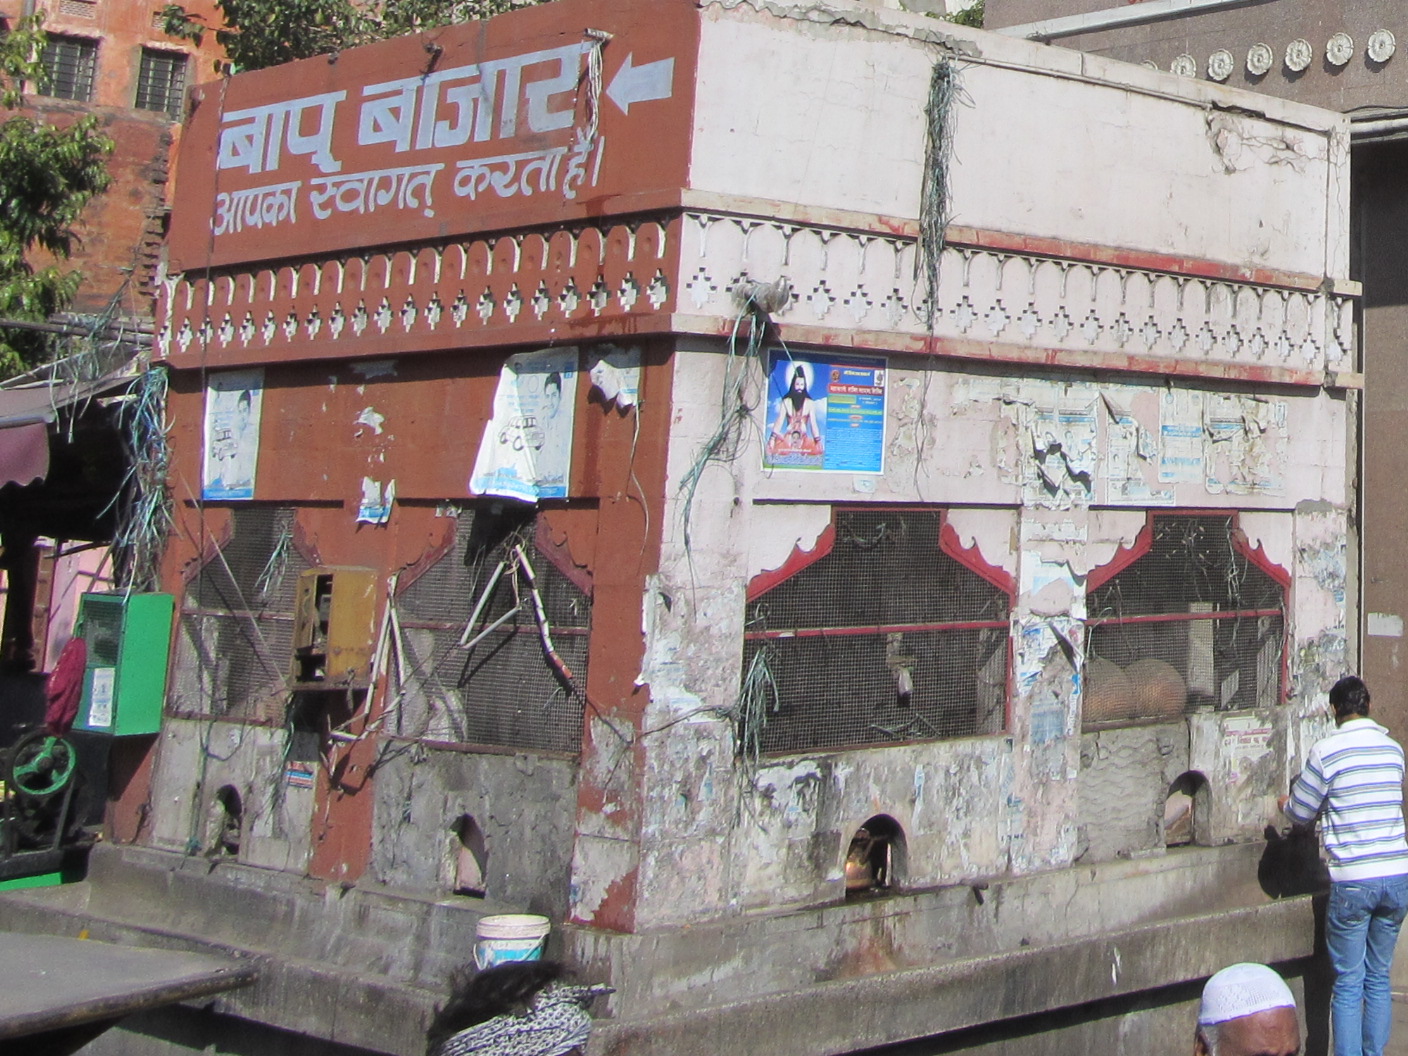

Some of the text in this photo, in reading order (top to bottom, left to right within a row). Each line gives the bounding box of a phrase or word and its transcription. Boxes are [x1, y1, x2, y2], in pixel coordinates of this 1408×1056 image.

[220, 40, 597, 174] बापू बाजार
[211, 180, 302, 236] आपका
[454, 146, 568, 201] करता
